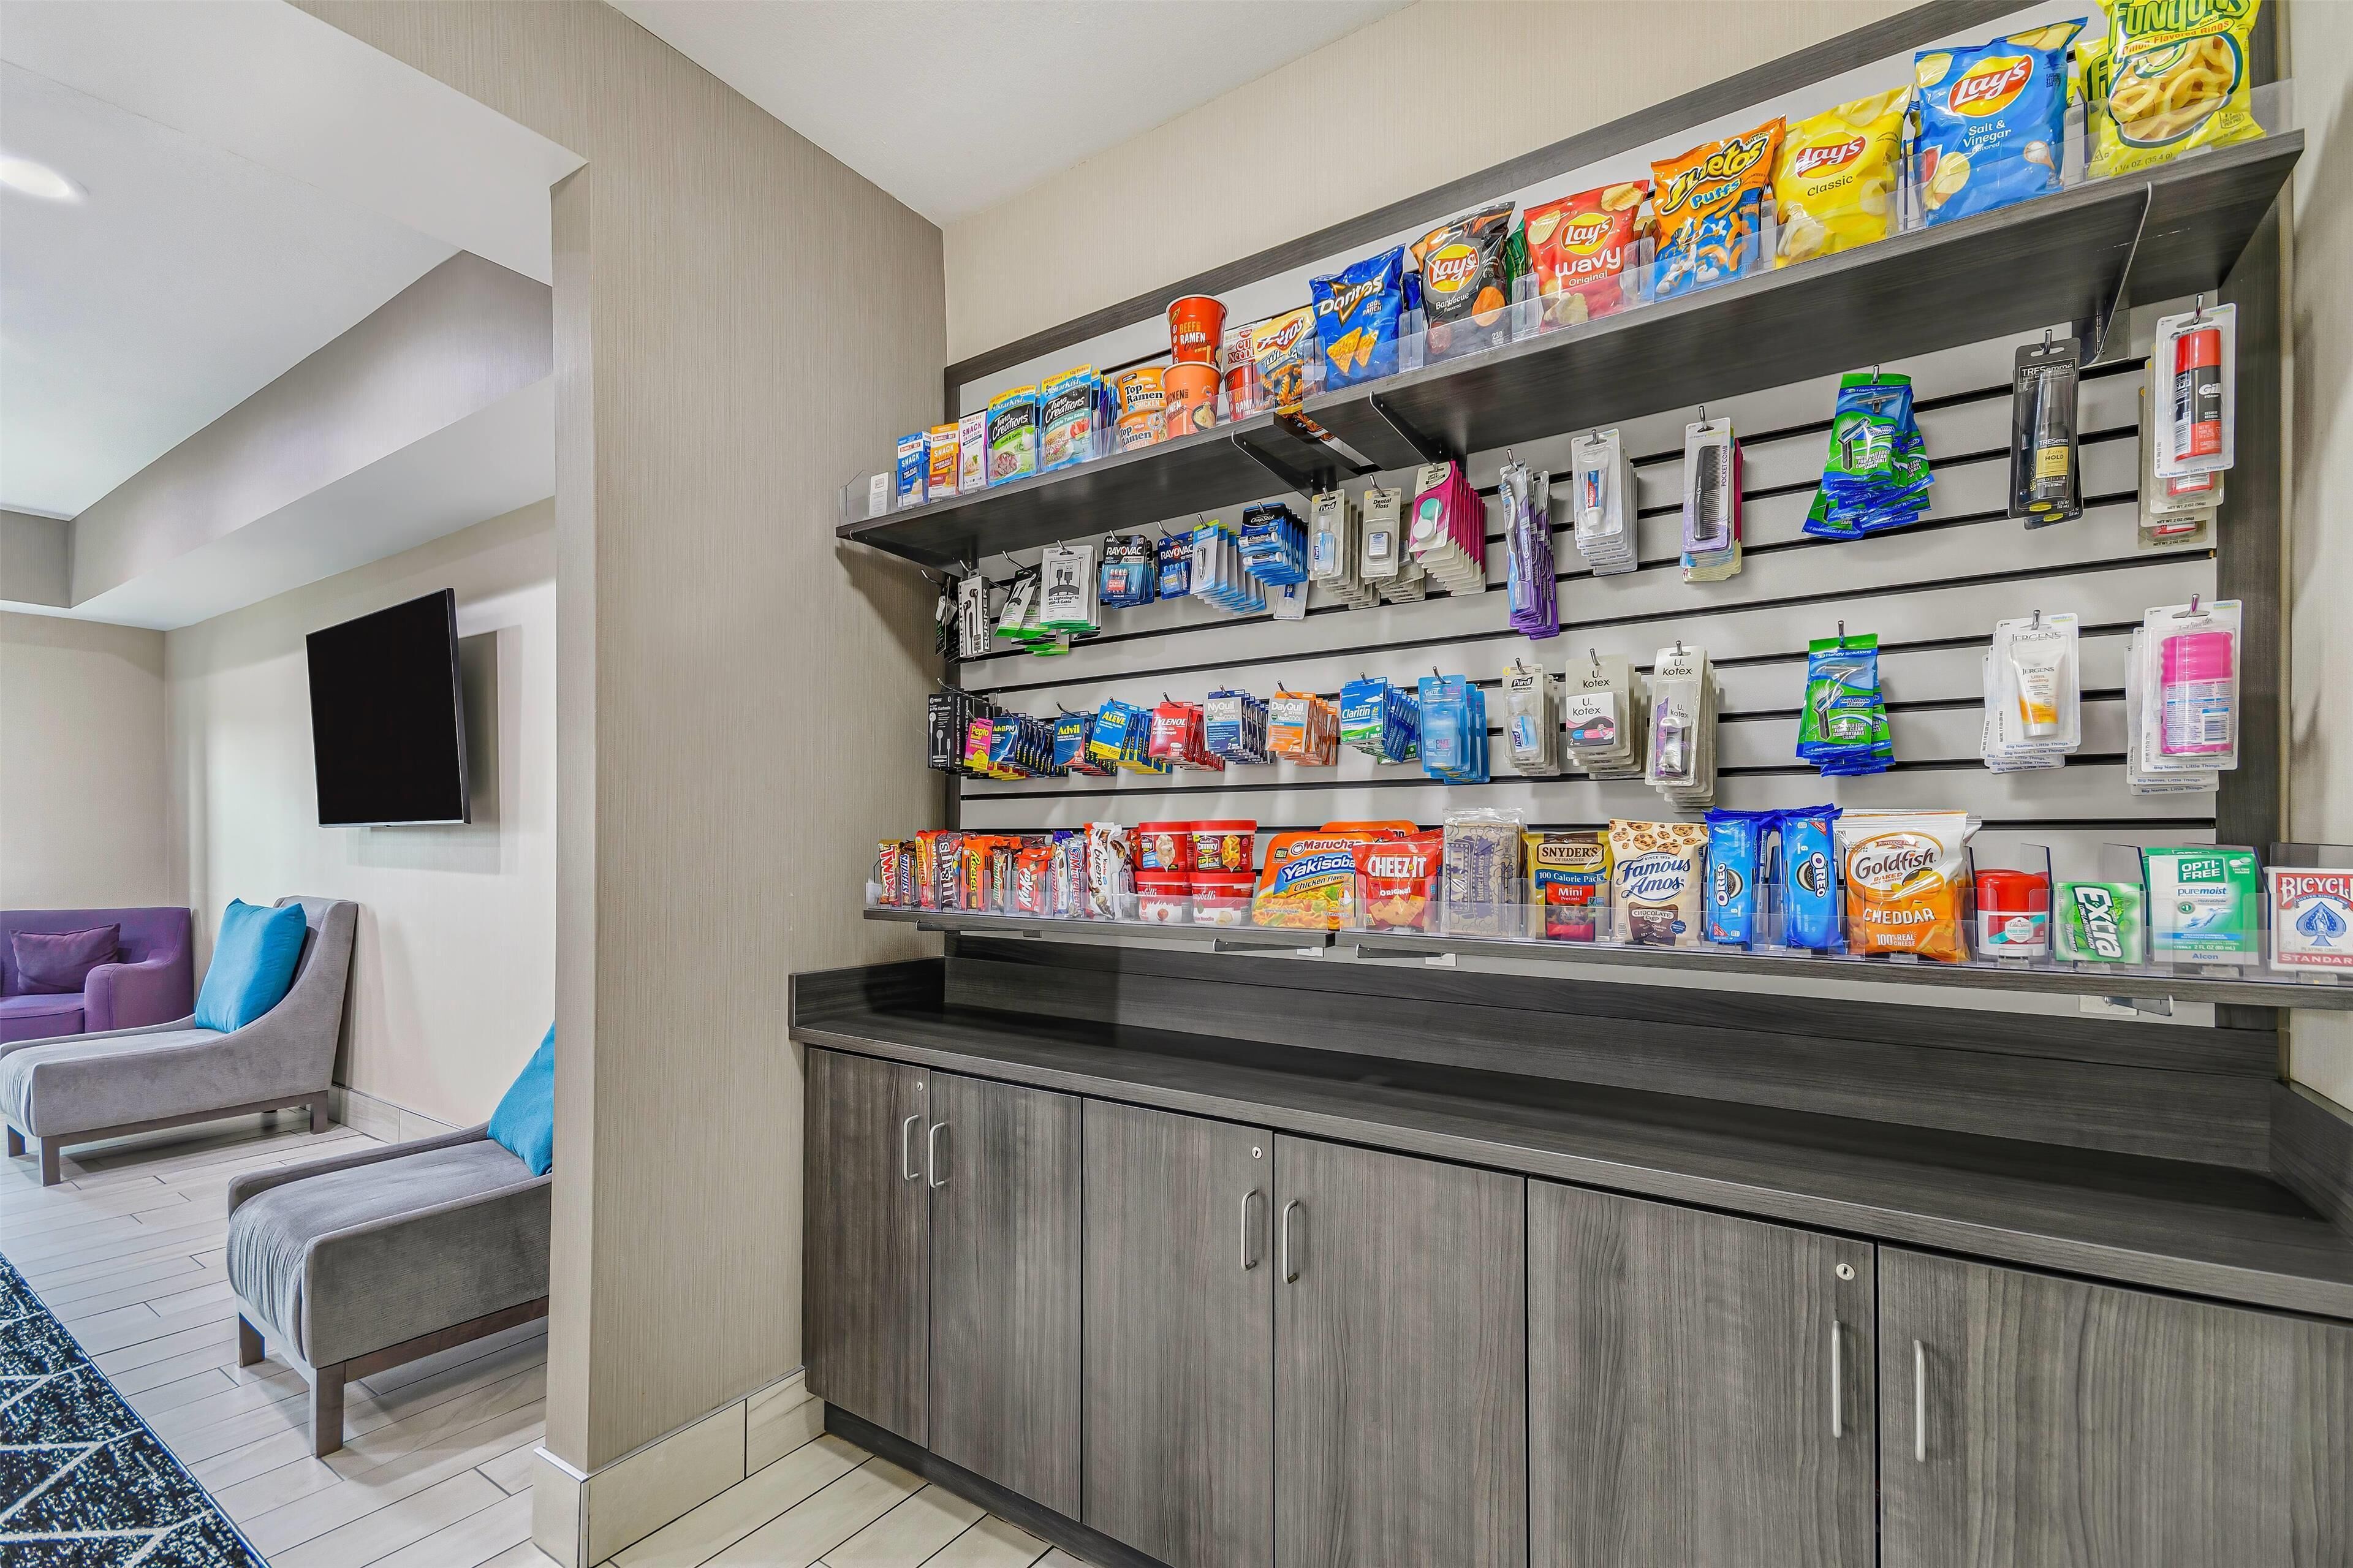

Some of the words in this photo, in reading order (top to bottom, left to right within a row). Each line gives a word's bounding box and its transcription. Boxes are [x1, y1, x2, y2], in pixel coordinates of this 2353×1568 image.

[2200, 17, 2218, 26] BRAND
[2154, 29, 2197, 44] Flavored
[2201, 19, 2229, 33] Rings
[1953, 59, 2026, 105] Lay's
[1968, 122, 1993, 135] Salt
[1995, 119, 2006, 129] &
[1963, 127, 2012, 148] Vinegar
[1797, 139, 1863, 170] Lay's
[1808, 175, 1853, 197] Classic
[1690, 179, 1741, 209] Puffs
[1565, 219, 1610, 246] Lay's
[1433, 253, 1476, 283] Lay's
[1555, 247, 1621, 277] wavy
[1569, 269, 1608, 286] Original
[1320, 276, 1382, 316] Doritos
[1436, 293, 1469, 310] Barbecue
[1363, 305, 1382, 316] RANCH
[1367, 300, 1381, 308] COOL
[1180, 322, 1195, 334] BEEF
[1257, 317, 1304, 352] Fritos
[1180, 333, 1206, 344] RAMEN
[1228, 350, 1254, 364] NOODL
[1124, 385, 1142, 395] Top
[1048, 396, 1067, 409] Tuna
[1127, 392, 1163, 404] Ramen
[1135, 400, 1160, 409] CHICKEN
[1045, 396, 1085, 423] Creations
[992, 413, 1028, 441] Creations
[995, 414, 1010, 428] Tuna
[962, 422, 982, 436] SNACK
[1120, 426, 1132, 437] Top
[1121, 431, 1152, 447] Ramen
[934, 445, 953, 456] SNACK
[901, 453, 920, 467] SNACK
[1106, 547, 1143, 555] RAYOVAC
[1161, 544, 1193, 560] RAYOVAC
[2022, 666, 2055, 675] JERGENS
[1513, 676, 1533, 687] Purell
[1208, 703, 1235, 711] NyQuil
[1271, 702, 1304, 712] DayQuil
[1342, 708, 1371, 719] Claritin
[1102, 711, 1126, 725] ALEVE
[1154, 717, 1187, 725] TYLENOL
[972, 725, 988, 737] Pepto
[1058, 725, 1080, 735] Advil
[1542, 847, 1599, 857] SNYDER'S
[1284, 857, 1355, 880] Yakisoba
[1855, 848, 1936, 879] Goldfish
[2181, 860, 2219, 872] OPTI-
[880, 846, 896, 896] TWIX
[1617, 858, 1692, 885] Famous
[1811, 852, 1826, 897] OREO
[1873, 873, 1903, 882] BAKED
[2183, 869, 2221, 880] FREE
[1293, 877, 1326, 892] Chicken
[1553, 874, 1582, 882] Calorie
[1583, 874, 1602, 883] Pack
[1716, 863, 1730, 906] OREO
[1558, 887, 1583, 896] Mini
[1622, 876, 1684, 899] Amos
[2280, 876, 2353, 907] BICYCL
[1863, 908, 1936, 925] CHEDDAR
[2281, 953, 2353, 964] STANDAR
